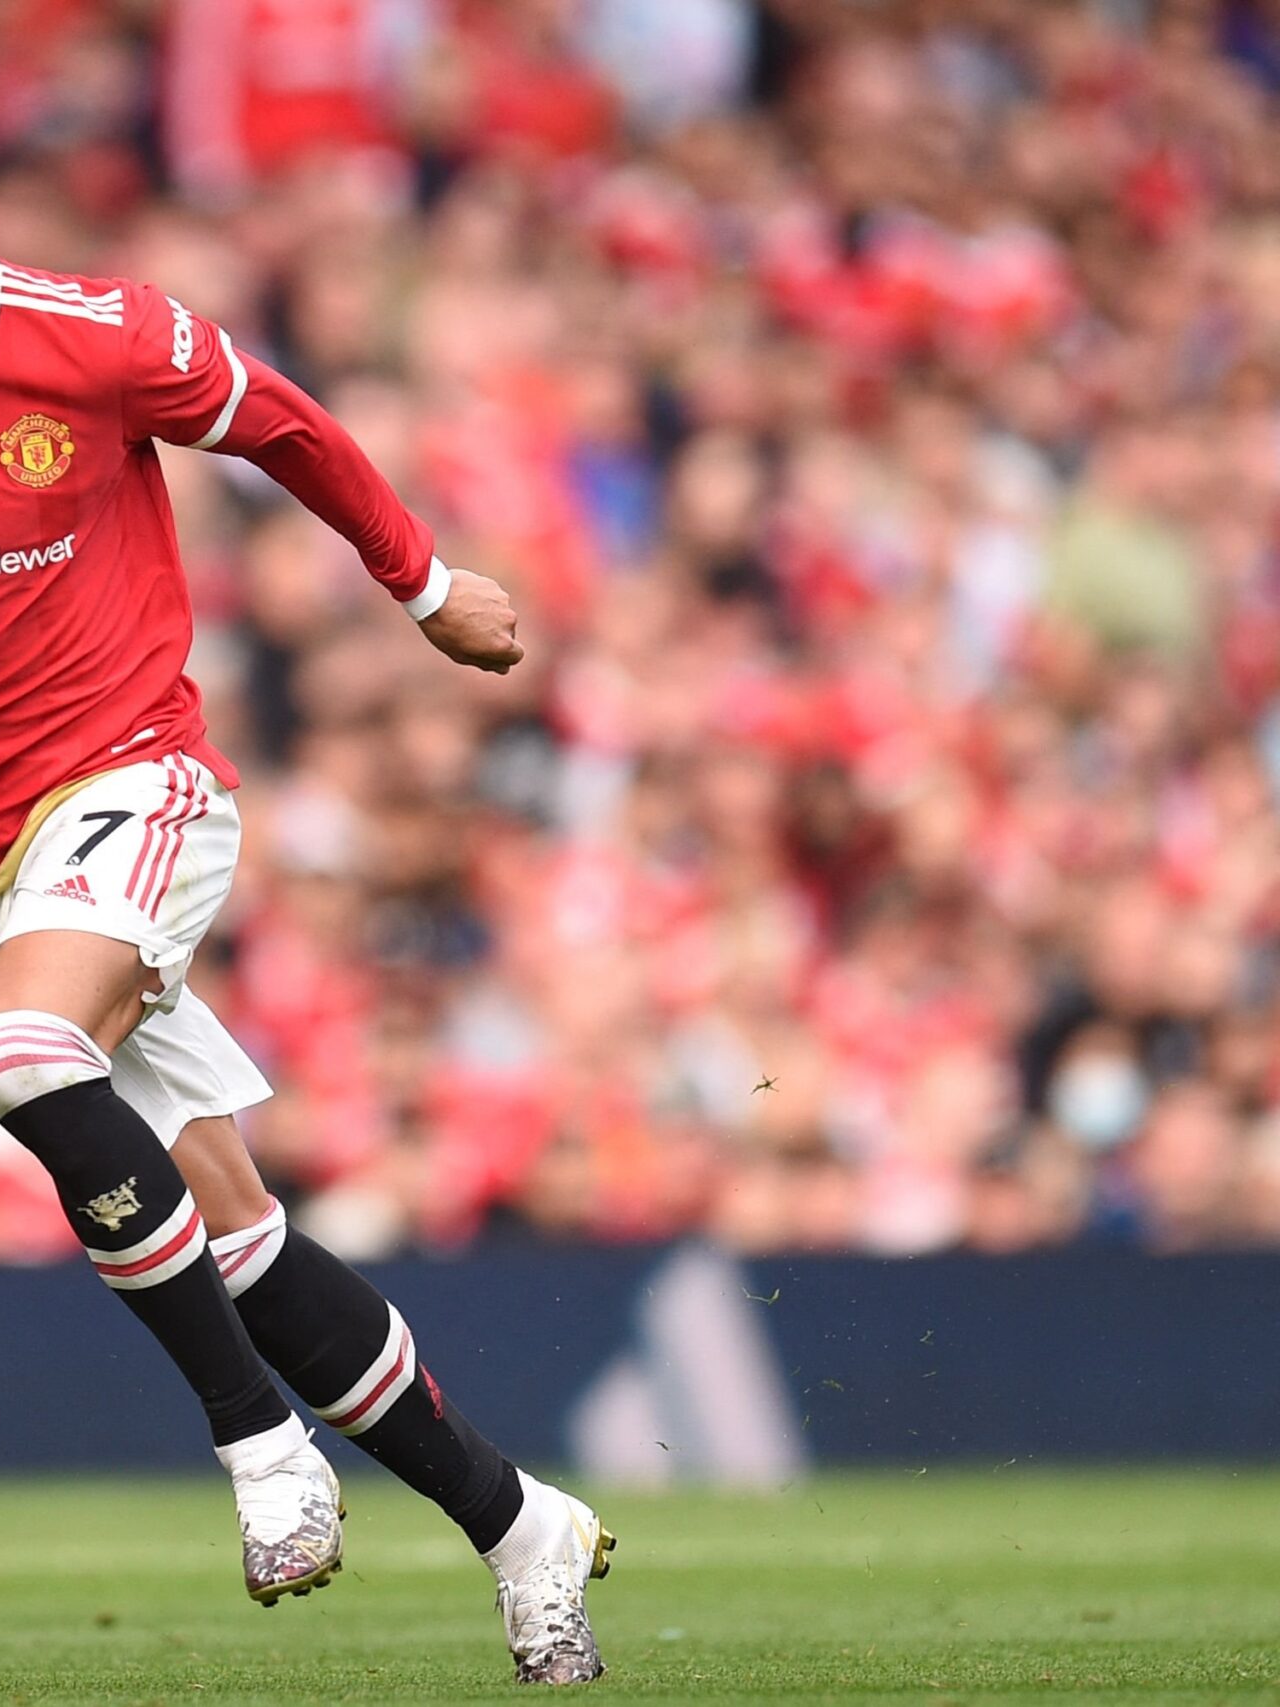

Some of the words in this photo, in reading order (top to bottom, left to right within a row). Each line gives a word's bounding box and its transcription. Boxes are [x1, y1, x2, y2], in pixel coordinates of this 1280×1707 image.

[6, 419, 65, 445] MANCHESTER
[20, 466, 62, 482] UNITED
[64, 809, 136, 866] 7
[43, 888, 96, 906] adidas
